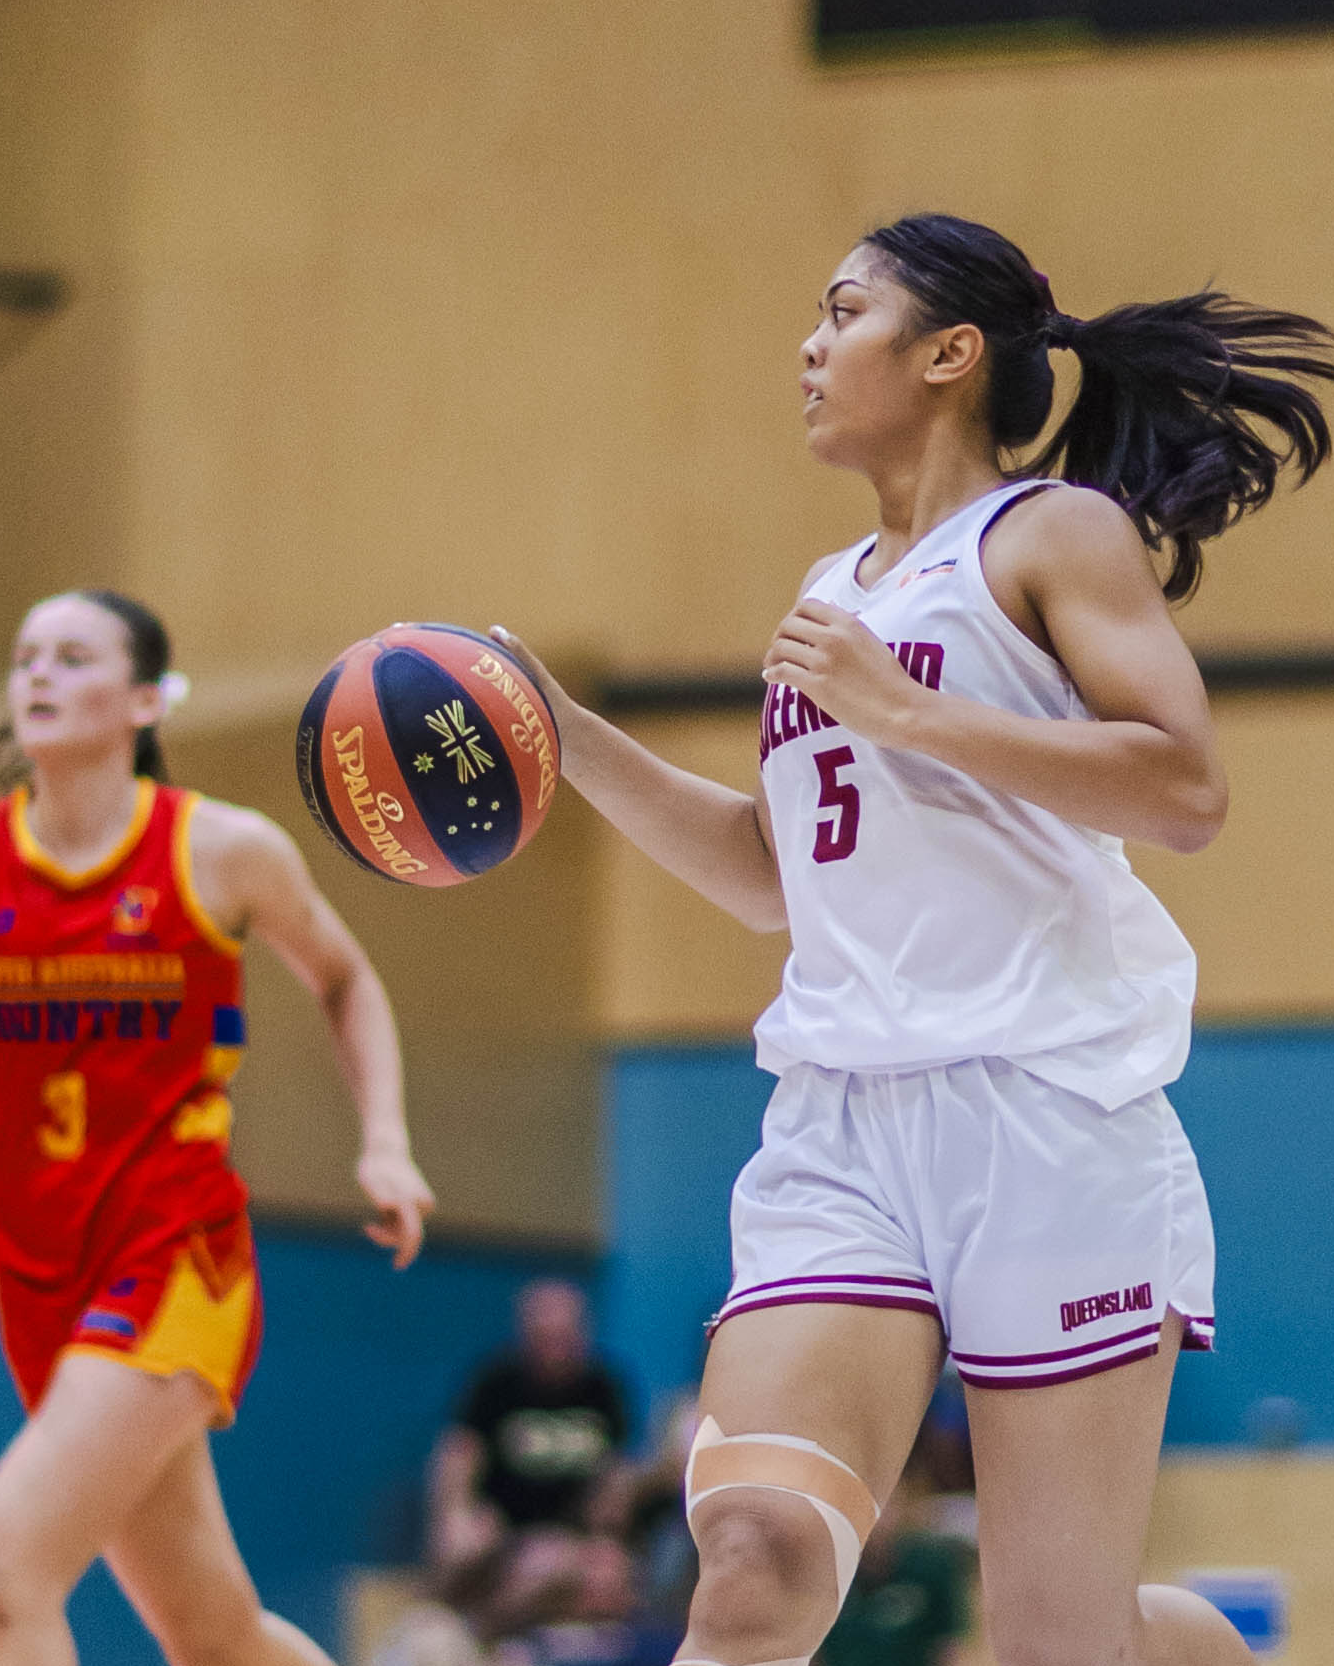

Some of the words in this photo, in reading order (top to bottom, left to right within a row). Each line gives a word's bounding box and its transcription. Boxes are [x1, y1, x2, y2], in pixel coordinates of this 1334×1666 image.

[332, 725, 428, 875] SPALDING
[812, 744, 860, 864] 5
[38, 1069, 88, 1165] 3
[1060, 1282, 1153, 1332] QUEENSLAND
